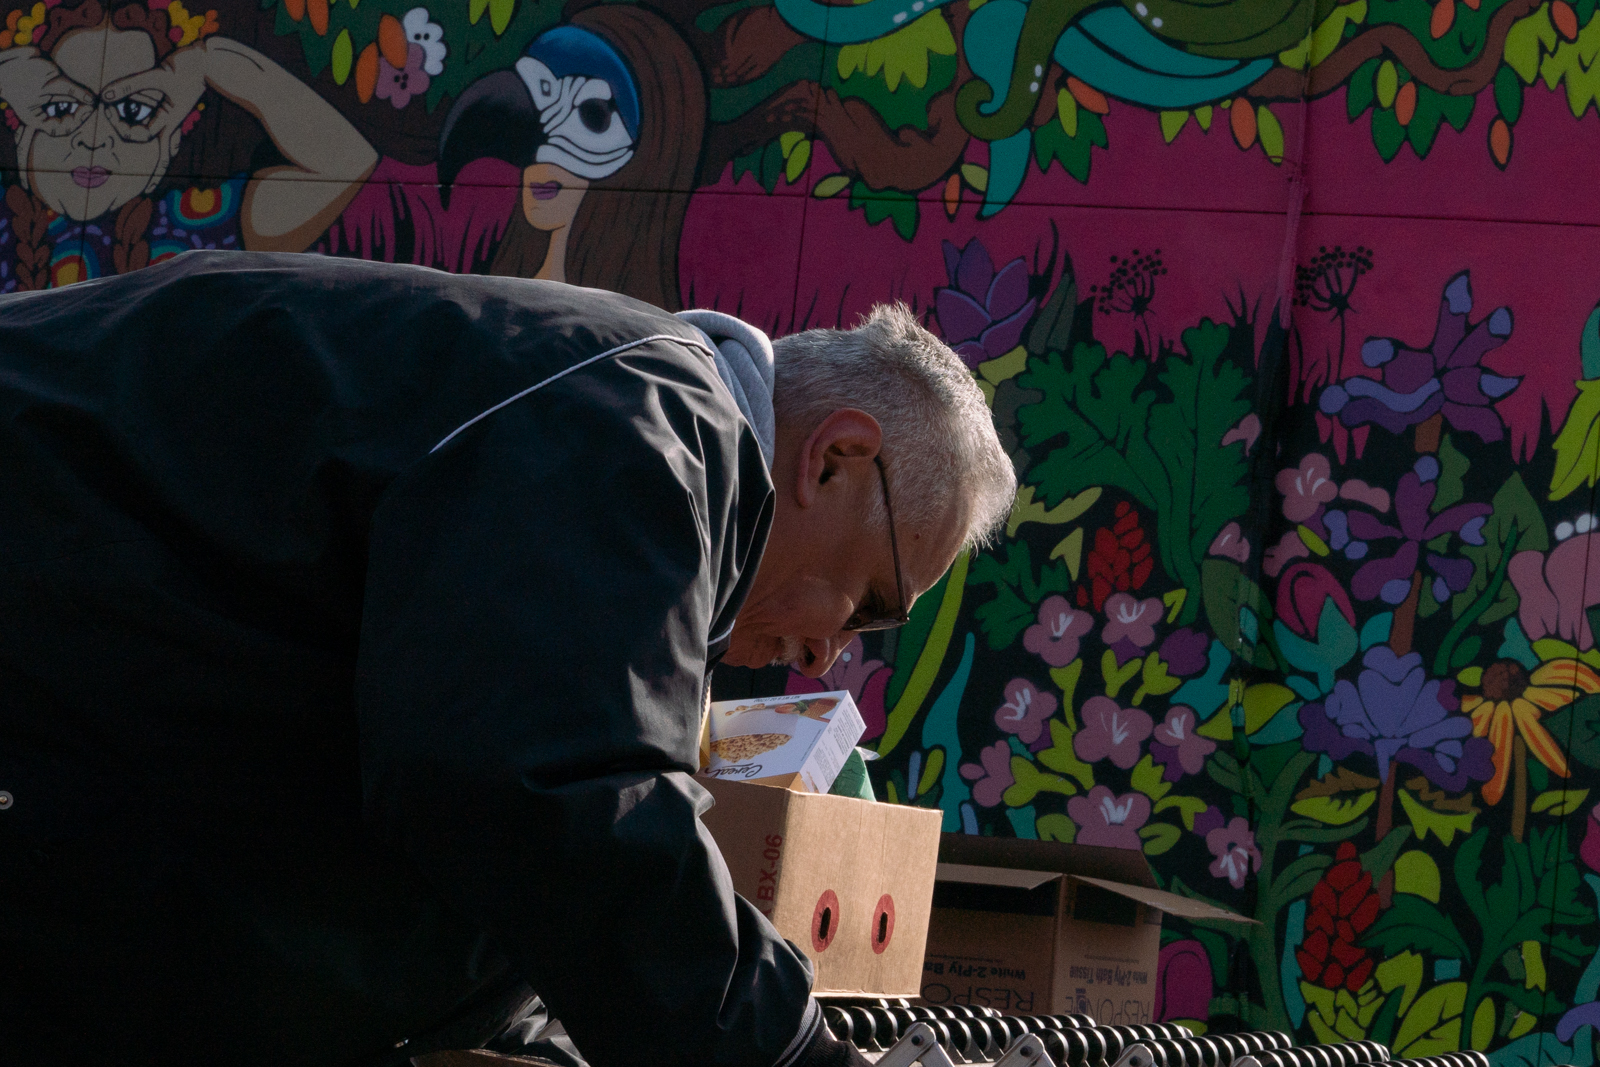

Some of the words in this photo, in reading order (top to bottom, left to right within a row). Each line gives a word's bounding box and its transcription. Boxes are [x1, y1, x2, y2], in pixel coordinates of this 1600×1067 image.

[756, 834, 783, 902] BX-06
[924, 960, 944, 974] Ba
[948, 963, 990, 979] 2-Ply
[991, 966, 1026, 980] White
[921, 983, 1035, 1012] RESPO
